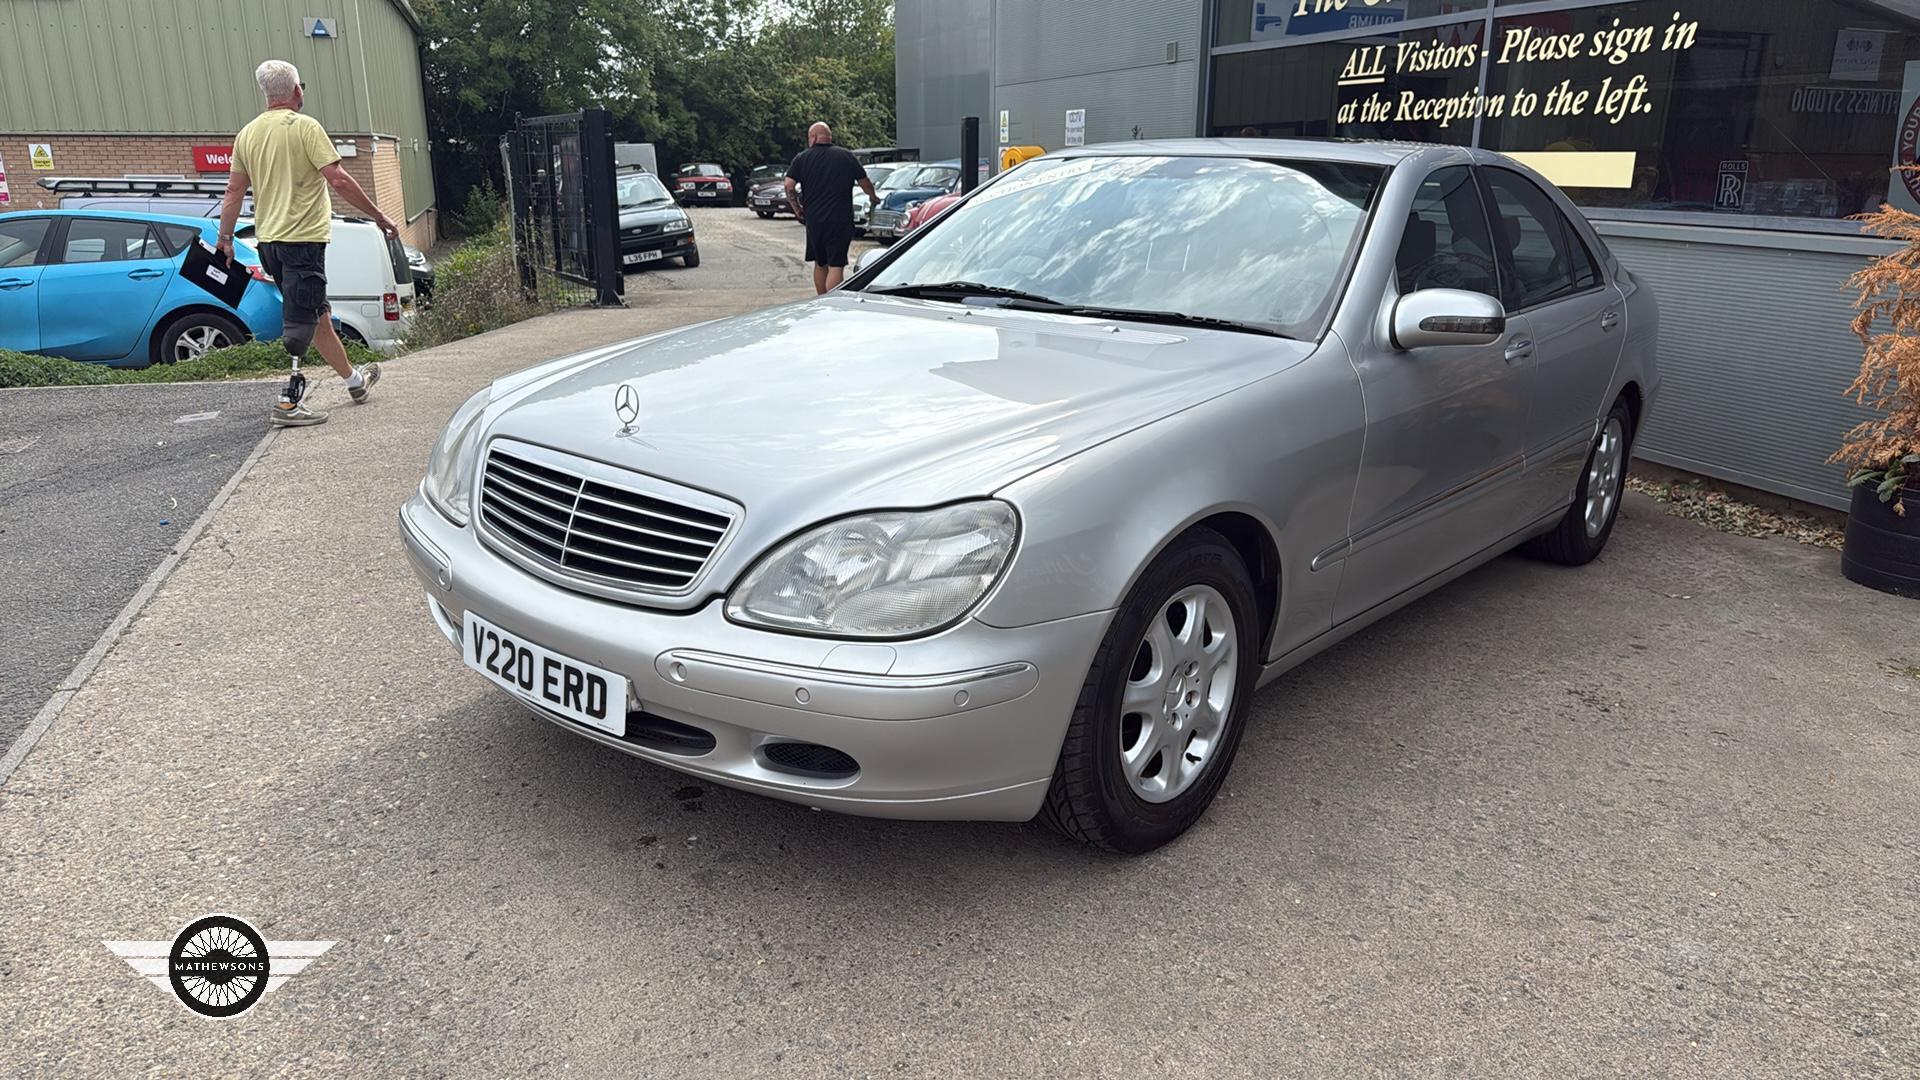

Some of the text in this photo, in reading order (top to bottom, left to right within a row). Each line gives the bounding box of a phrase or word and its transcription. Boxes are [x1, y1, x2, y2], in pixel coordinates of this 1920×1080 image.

[1339, 45, 1387, 79] ALL
[1396, 40, 1478, 74] Visitors
[1497, 26, 1585, 64] Please
[1588, 17, 1654, 65] sign
[1661, 11, 1699, 51] in
[1337, 74, 1652, 128] at the Reception to the left.
[472, 621, 607, 720] V220 ERD
